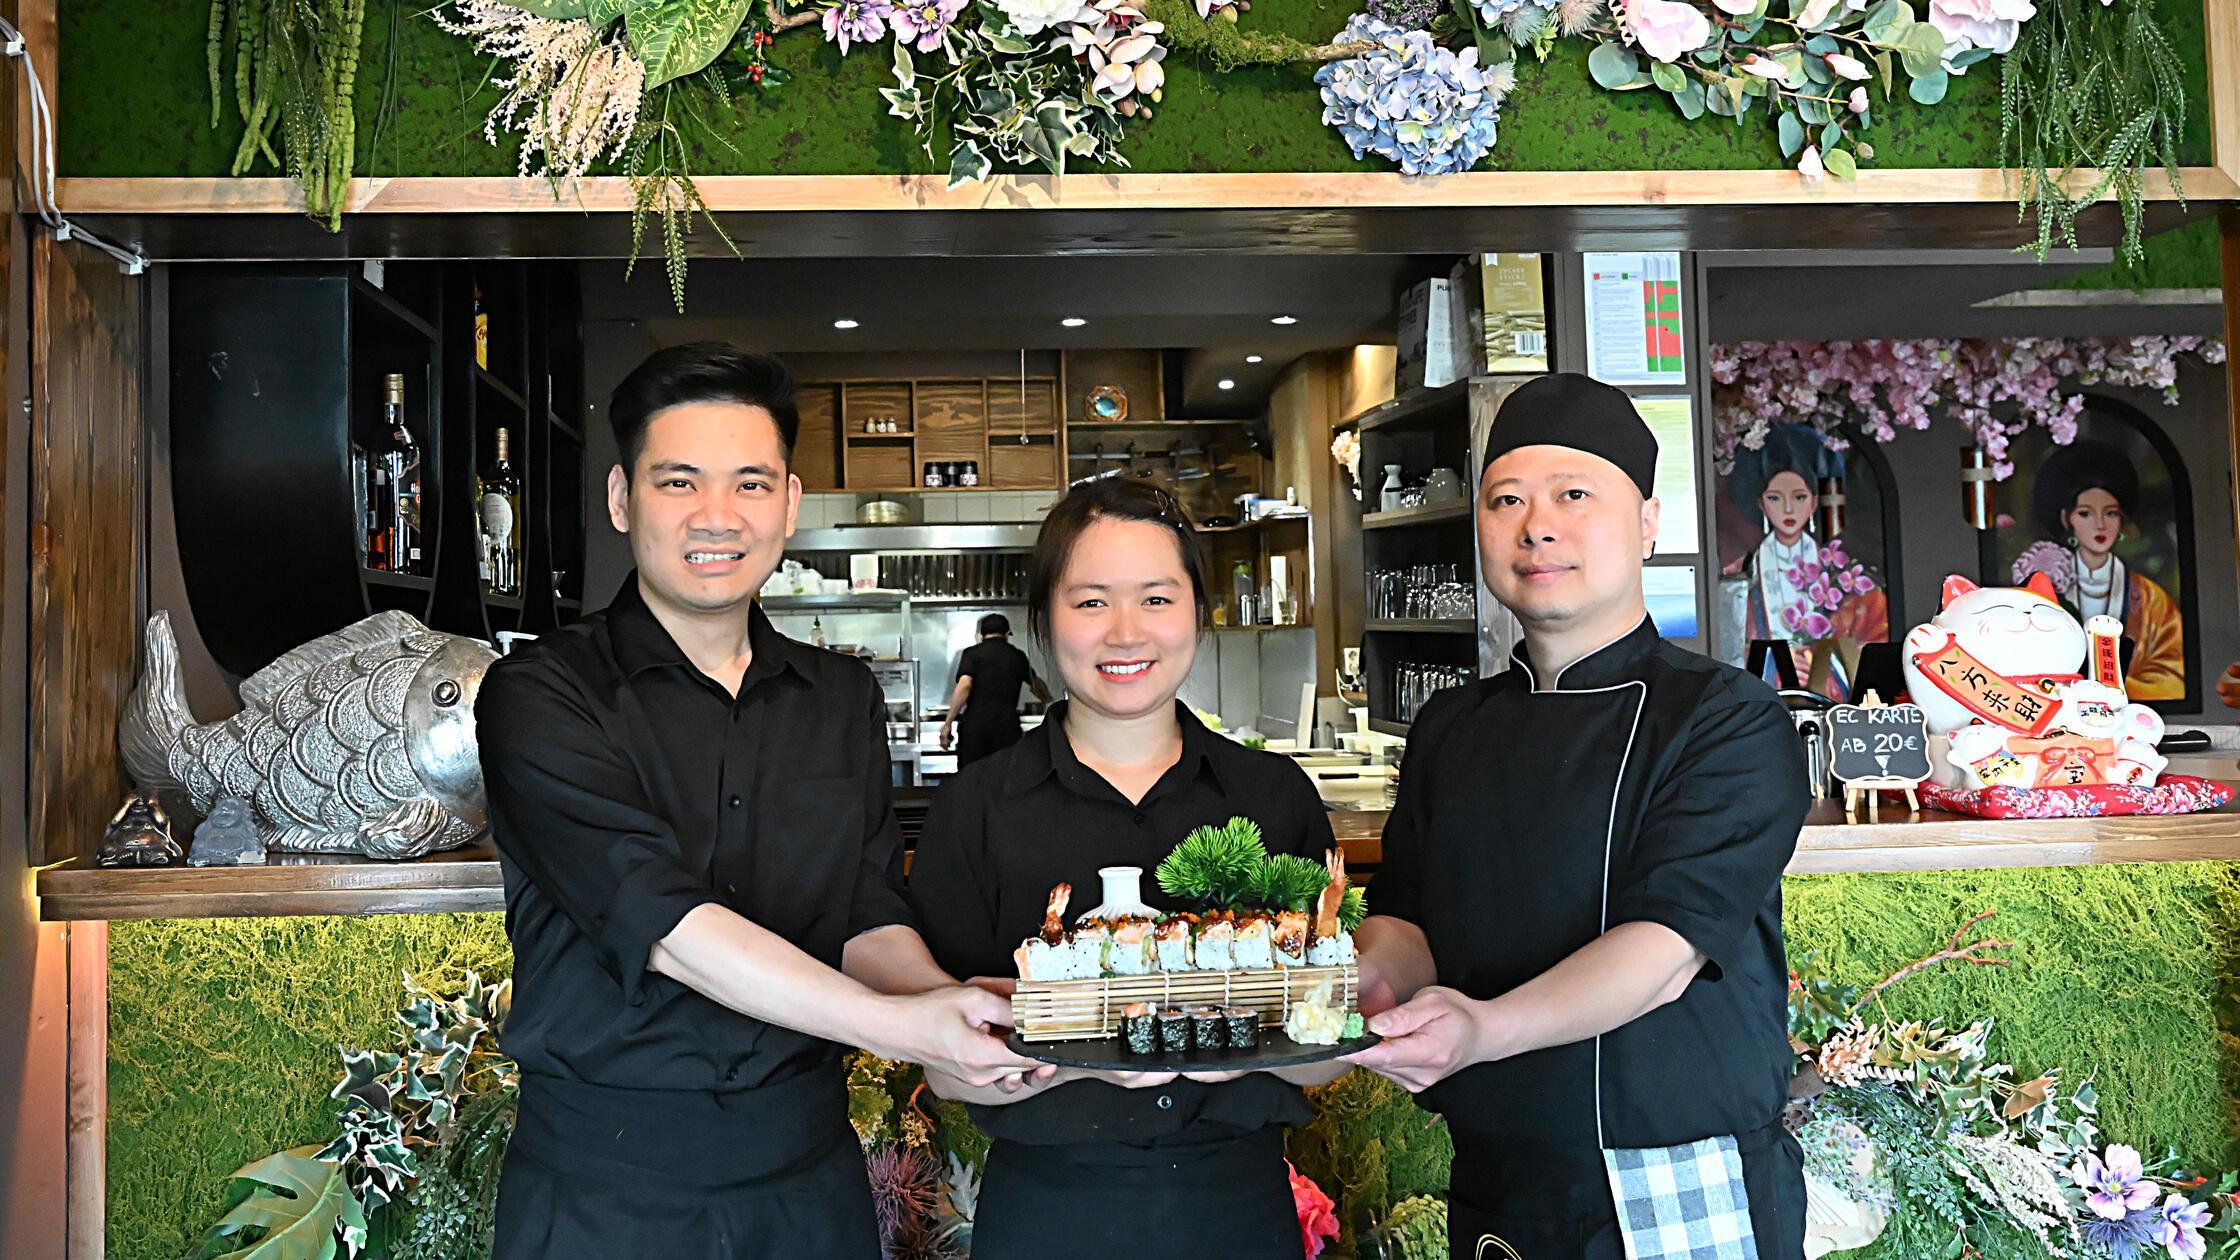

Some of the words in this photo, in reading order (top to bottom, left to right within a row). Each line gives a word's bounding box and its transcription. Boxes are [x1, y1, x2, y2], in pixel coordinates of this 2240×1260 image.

[1836, 709, 1859, 723] EC
[1868, 707, 1922, 724] KARTE
[1841, 738, 1867, 753] AB
[1874, 733, 1918, 753] 20€
